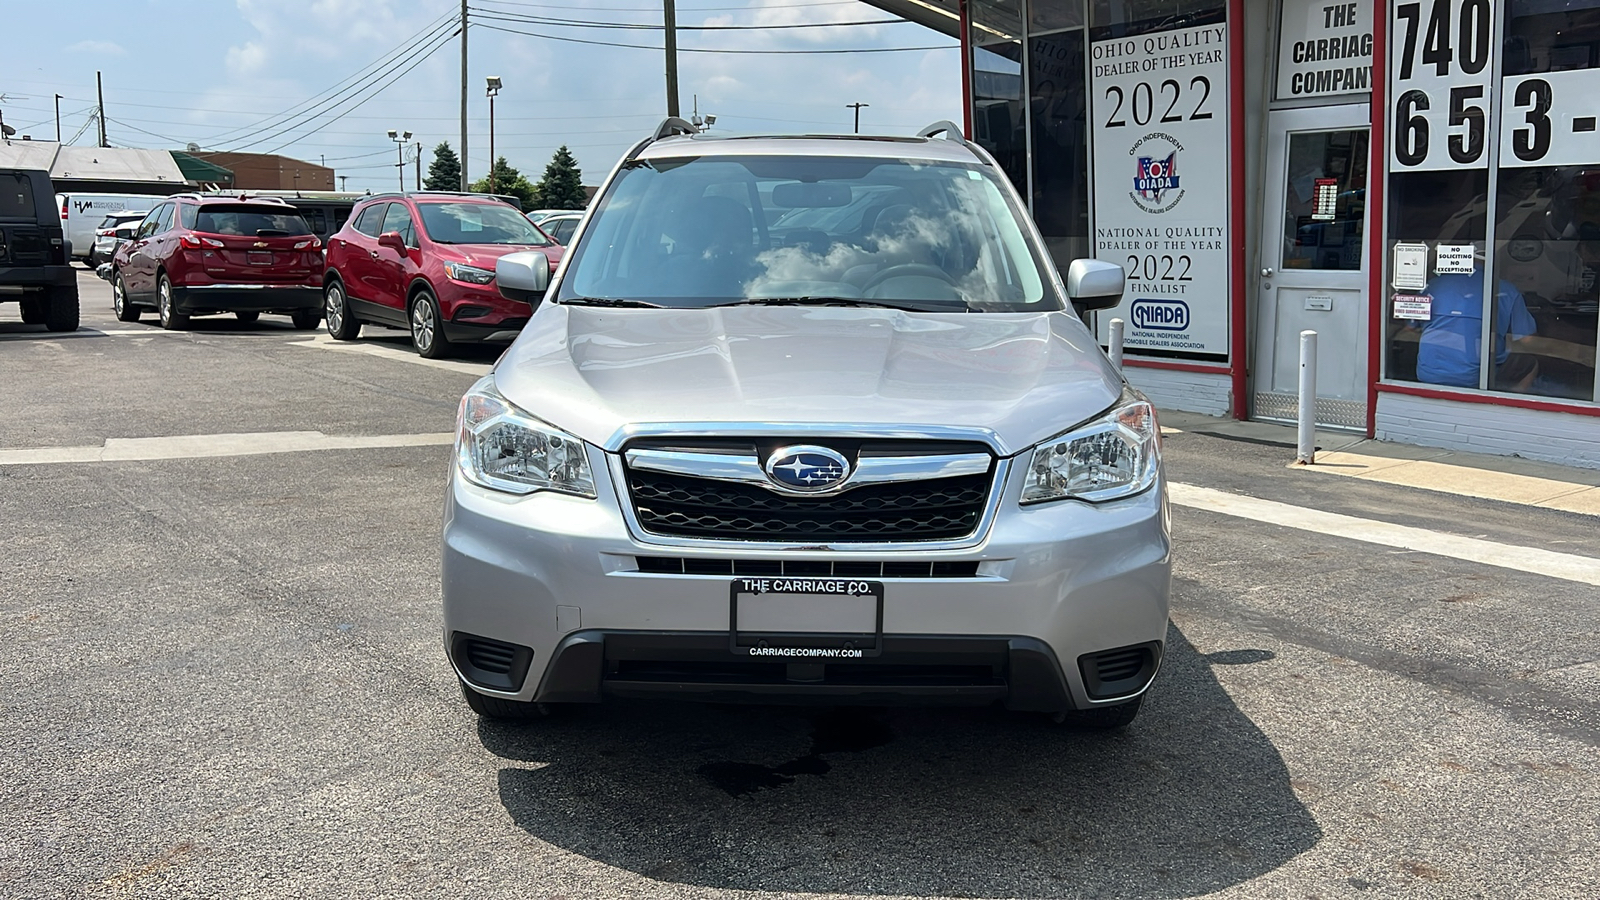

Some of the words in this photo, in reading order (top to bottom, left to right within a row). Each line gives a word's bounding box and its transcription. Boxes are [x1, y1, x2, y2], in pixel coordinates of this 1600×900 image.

[1323, 3, 1357, 28] THE
[1093, 41, 1136, 60] OHIO
[1144, 27, 1225, 55] QUALITY
[1292, 33, 1373, 64] CARRIAG
[1397, 0, 1490, 80] 740
[1095, 61, 1140, 78] DEALER
[1142, 58, 1158, 72] OF
[1160, 54, 1186, 70] THE
[1188, 49, 1223, 66] YEAR
[1104, 75, 1213, 128] 2022
[1129, 139, 1143, 156] OHIO
[1142, 132, 1185, 153] INDEPENDENT
[1139, 177, 1172, 190] OIADA
[1128, 191, 1148, 213] AUTOMOBILE
[1165, 189, 1186, 212] ASSOCIATION
[1097, 227, 1160, 238] NATIONAL
[1165, 227, 1224, 239] QUALITY
[1099, 241, 1141, 250] DEALER
[1145, 241, 1159, 250] OF
[1164, 241, 1187, 250] THE
[1191, 241, 1222, 250] YEAR
[1126, 254, 1193, 281] 2022
[1131, 283, 1187, 294] FINALIST
[1135, 305, 1184, 325] NIADA
[1156, 332, 1190, 340] INDEPENDENT
[1170, 341, 1205, 349] ASSOCIATION
[742, 579, 770, 591] THE
[773, 580, 845, 593] CARRIAGE
[848, 581, 872, 594] CO.
[749, 647, 862, 658] CARRIAGECOMPANY.COM
